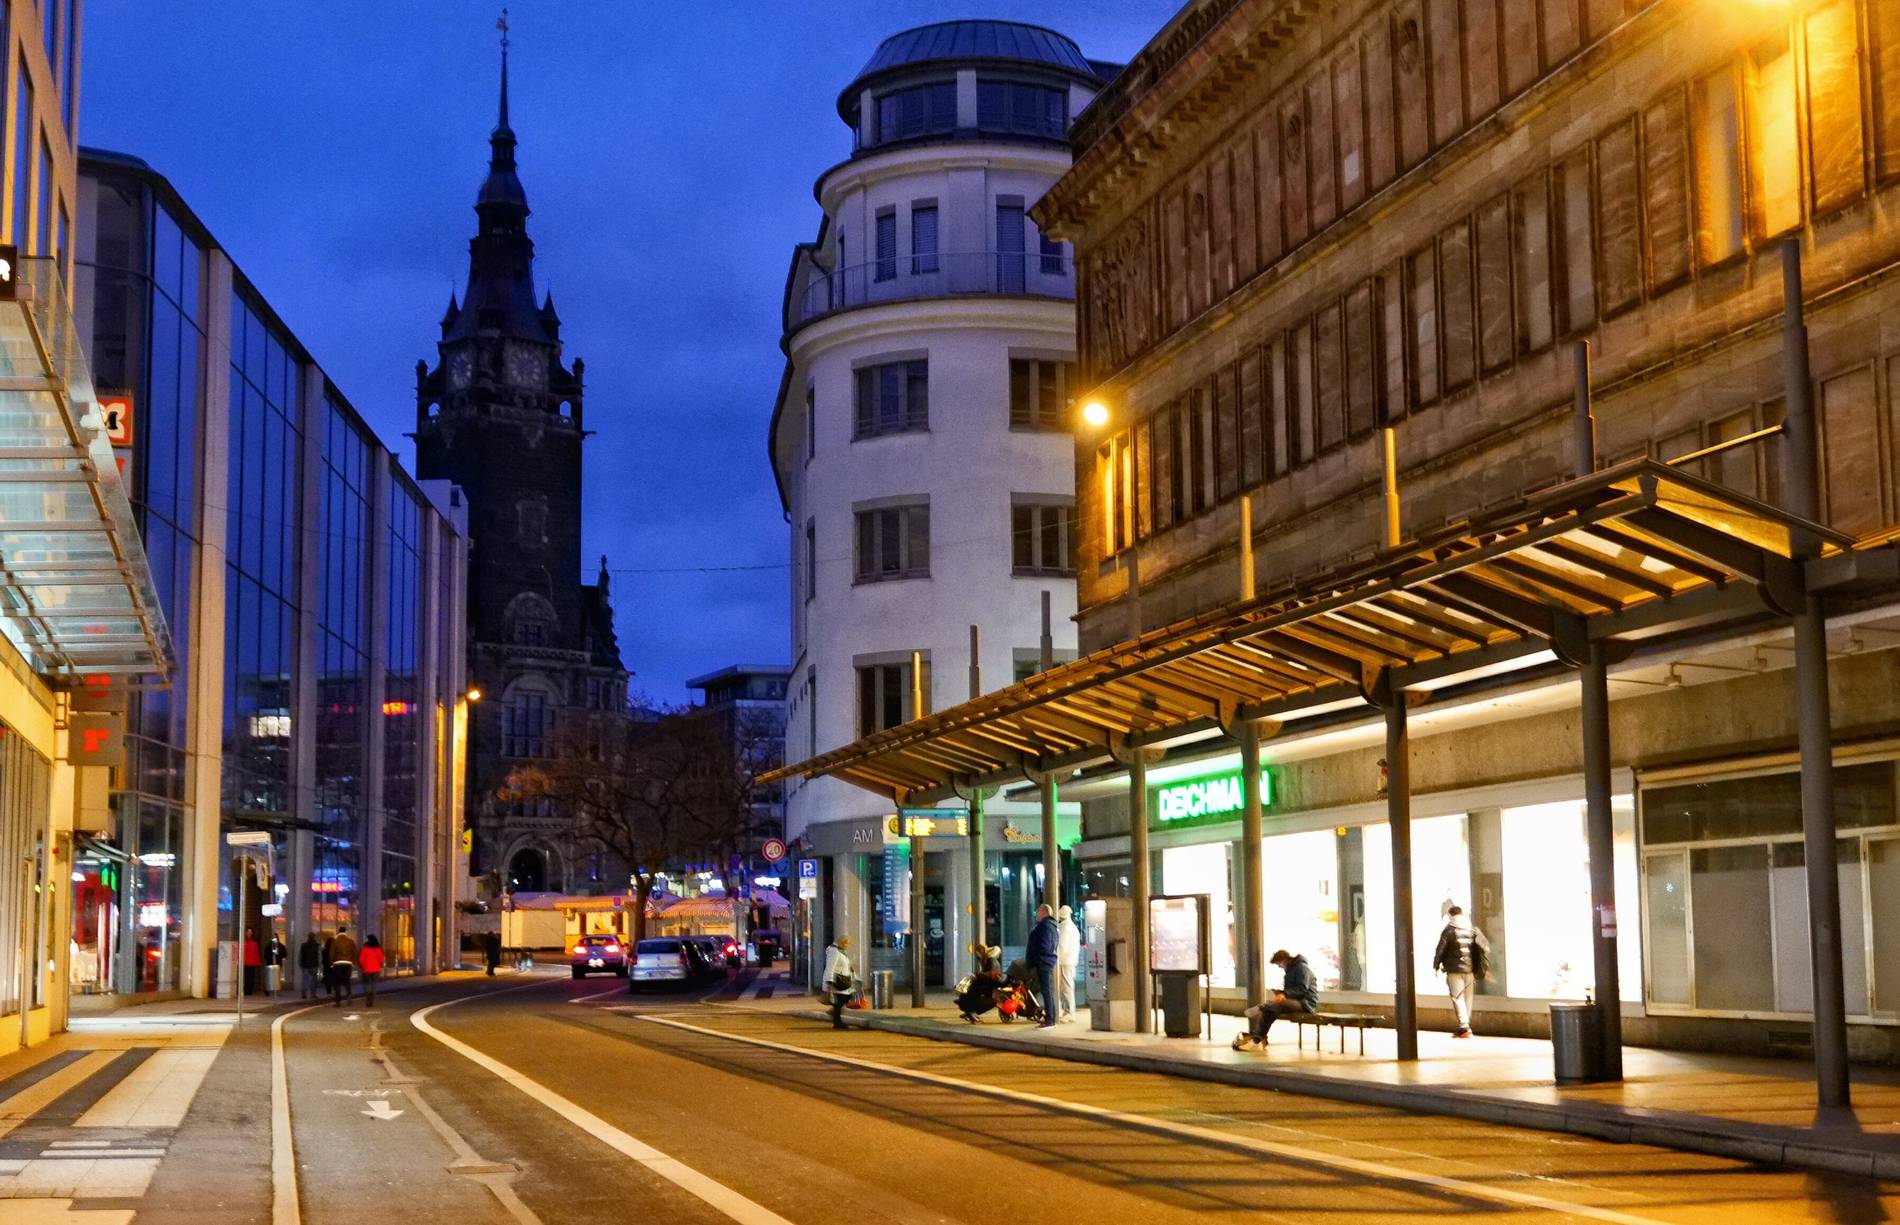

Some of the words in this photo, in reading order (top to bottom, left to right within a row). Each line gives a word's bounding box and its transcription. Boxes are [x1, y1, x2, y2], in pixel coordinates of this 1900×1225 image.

[1159, 770, 1270, 821] DEICHMAN
[853, 828, 873, 843] AM
[768, 844, 780, 856] 20
